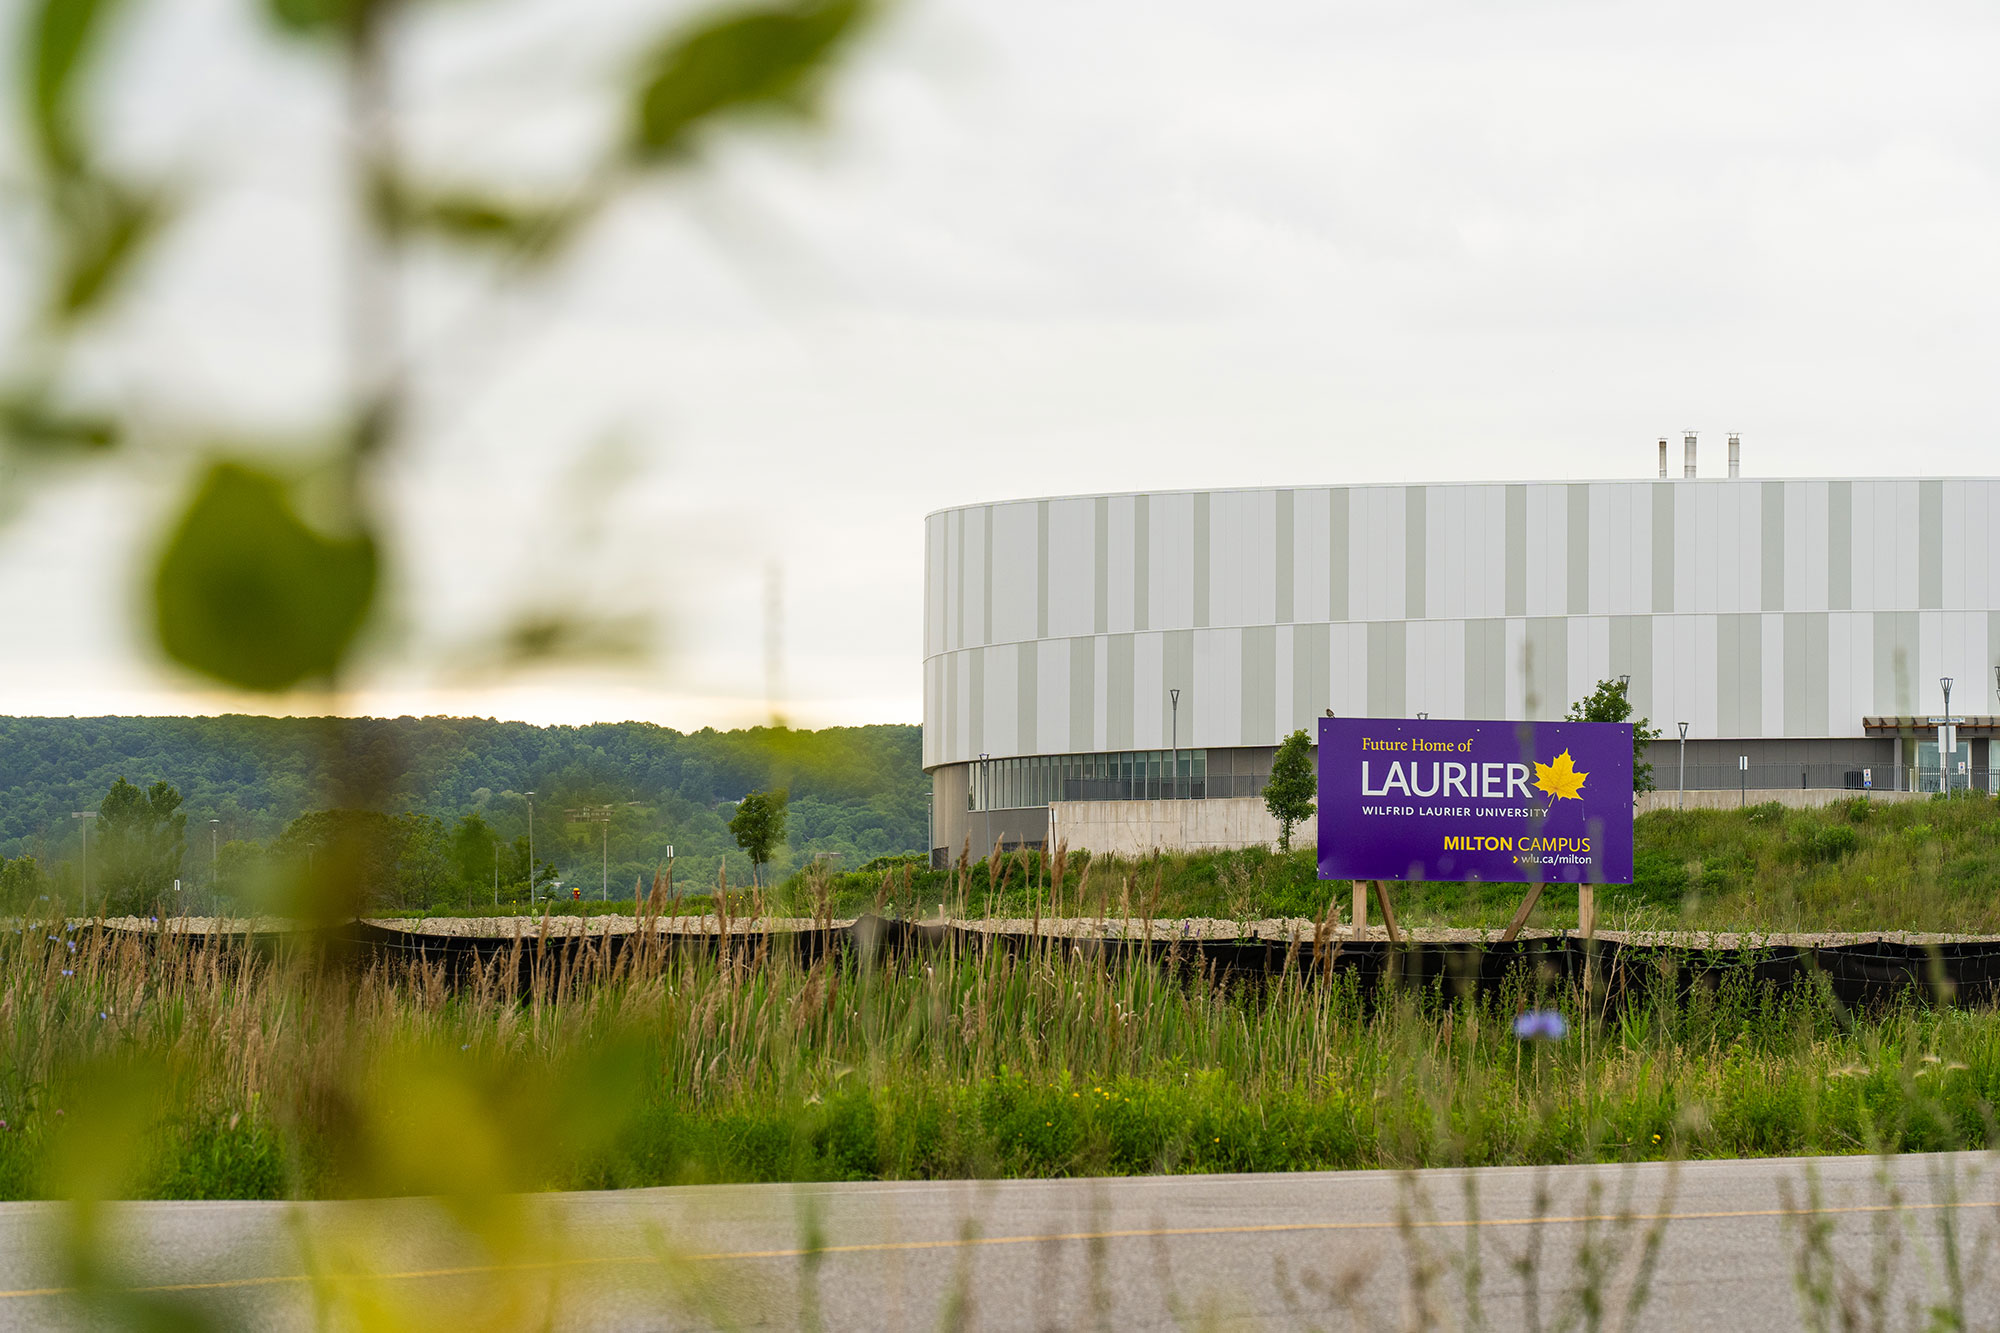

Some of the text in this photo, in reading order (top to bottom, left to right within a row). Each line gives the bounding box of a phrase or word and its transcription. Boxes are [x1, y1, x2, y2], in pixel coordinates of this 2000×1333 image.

[1362, 737, 1474, 752] Future Home of
[1362, 760, 1533, 798] LAURIER
[1362, 806, 1549, 818] WILFRID LAURIER UNIVERSITY
[1443, 836, 1591, 852] MILTON CAMPUS
[1521, 854, 1592, 866] wlu.ca/milton
